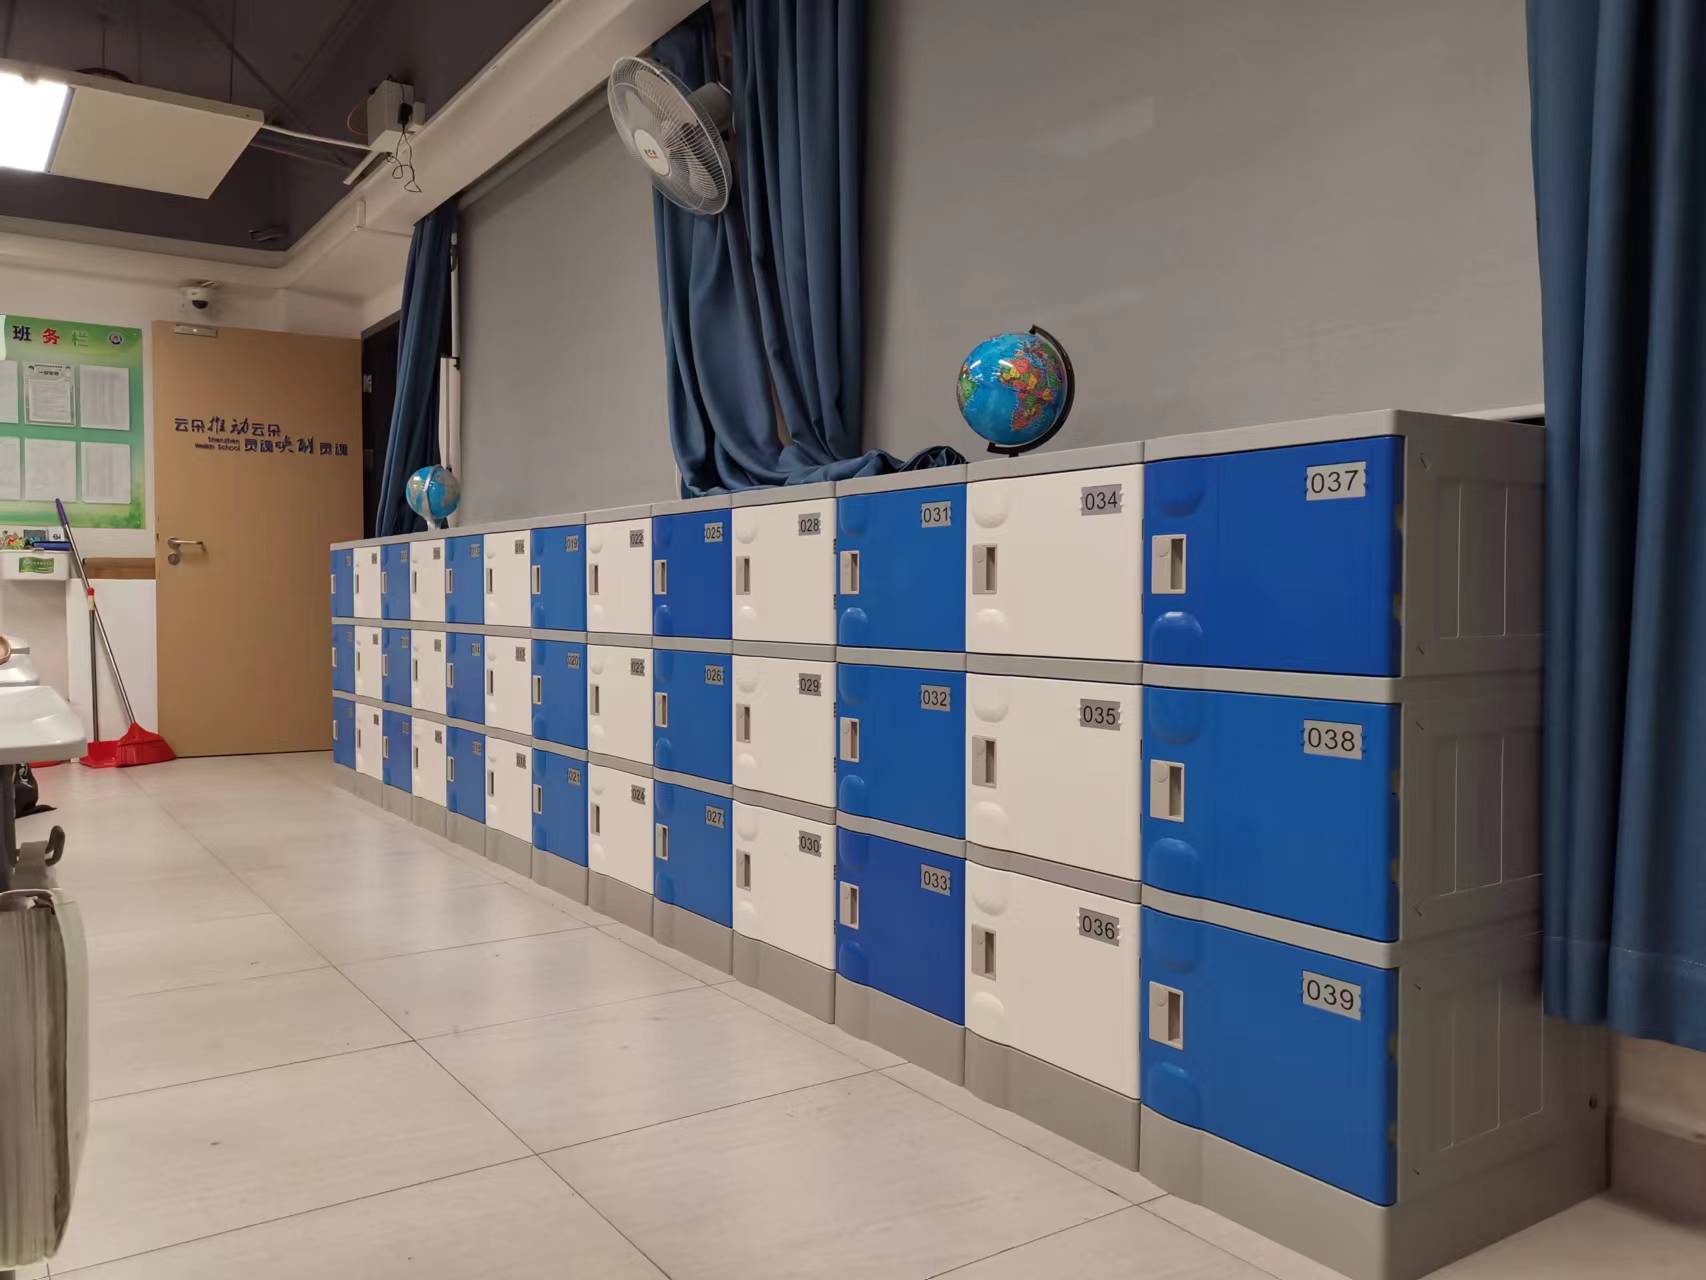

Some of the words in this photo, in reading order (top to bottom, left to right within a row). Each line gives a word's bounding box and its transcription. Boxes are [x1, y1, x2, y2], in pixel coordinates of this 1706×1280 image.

[12, 325, 89, 347] 班务栏
[1310, 469, 1359, 494] 037
[1084, 490, 1118, 511] 034
[922, 506, 949, 523] 031
[706, 526, 721, 539] 025
[800, 518, 819, 532] 028
[631, 533, 643, 545] 022
[706, 669, 722, 682] 026
[800, 678, 819, 693] 029
[922, 690, 947, 707] 032
[1083, 705, 1116, 726] 035
[1307, 727, 1355, 752] 038
[706, 809, 722, 824] 027
[800, 836, 819, 853] 030
[923, 871, 948, 891] 033
[1082, 915, 1115, 940] 036
[1306, 979, 1354, 1011] 039
